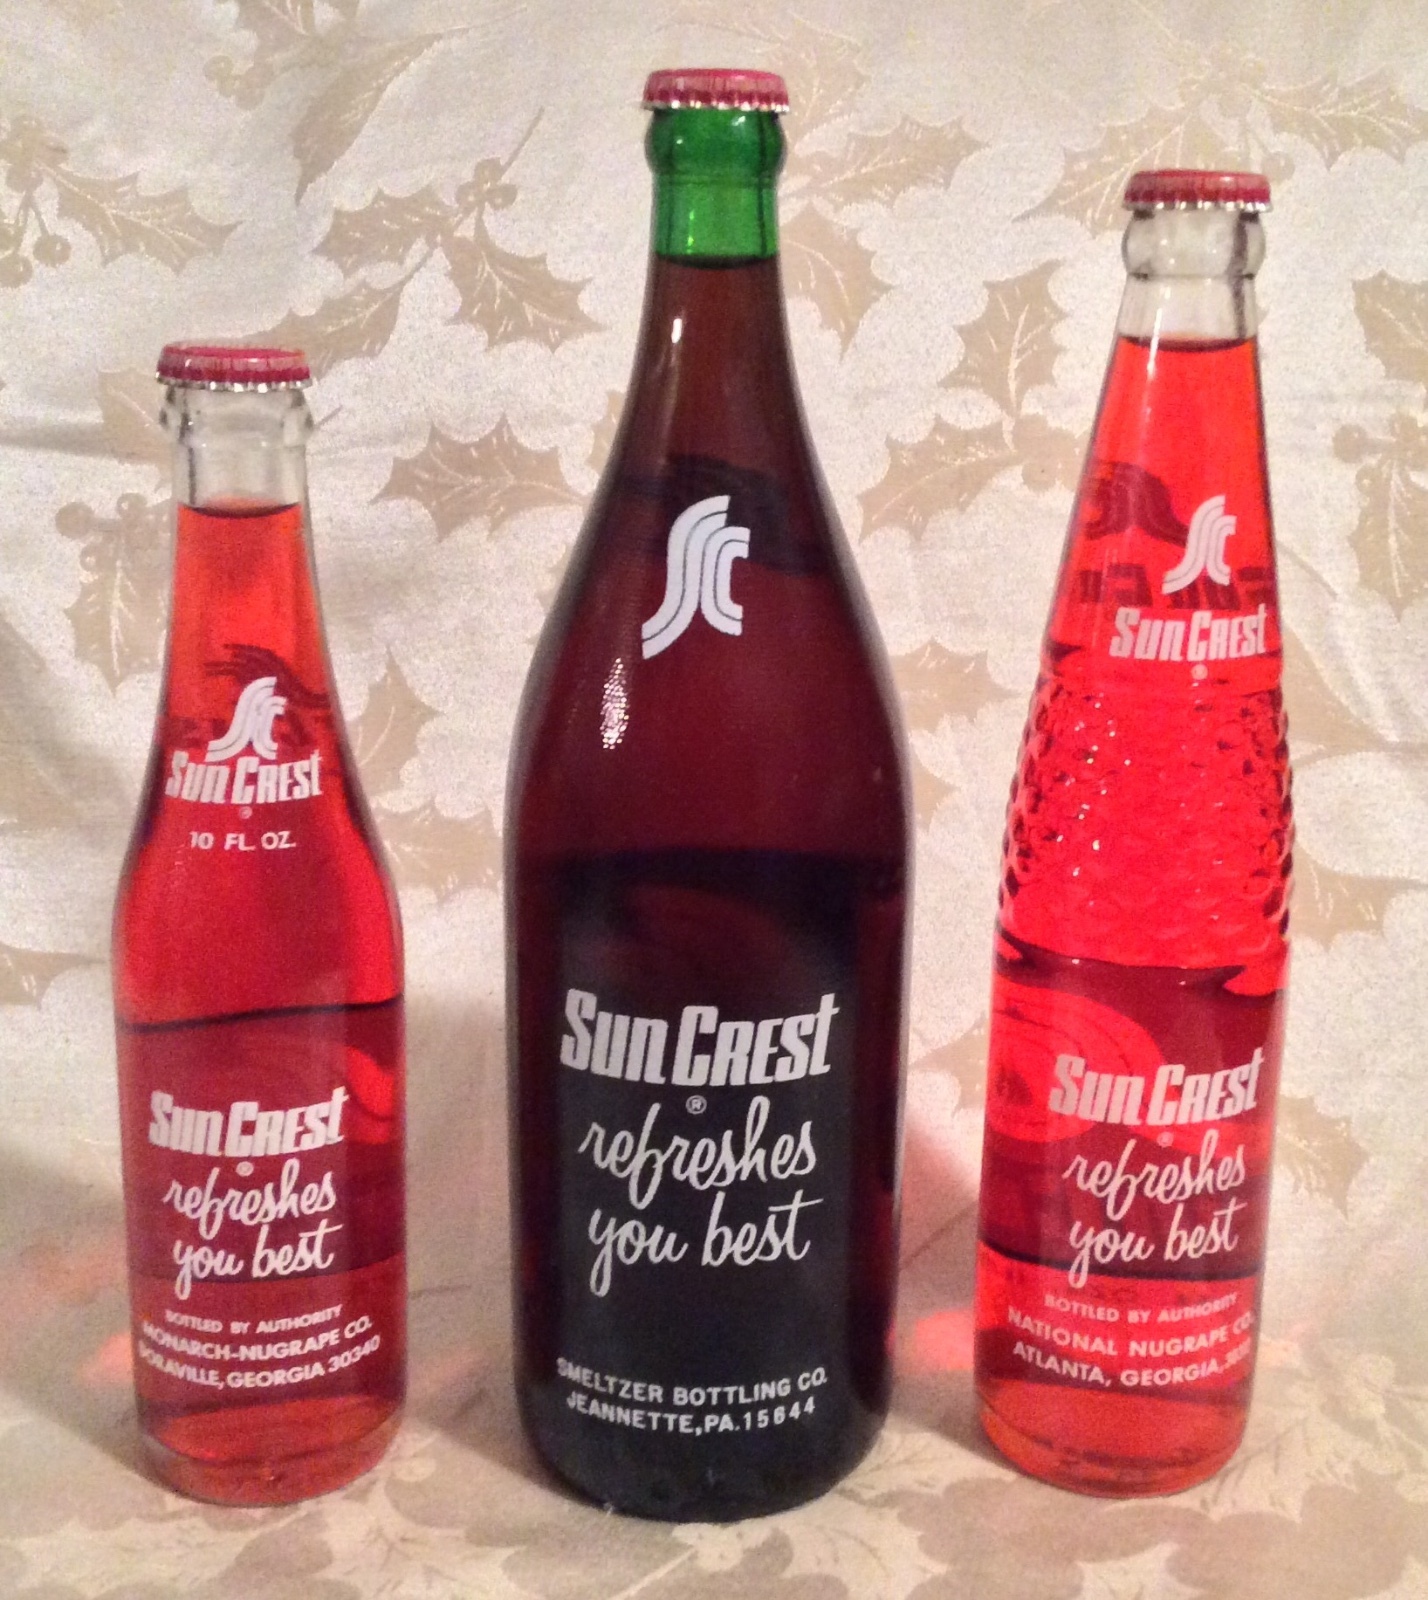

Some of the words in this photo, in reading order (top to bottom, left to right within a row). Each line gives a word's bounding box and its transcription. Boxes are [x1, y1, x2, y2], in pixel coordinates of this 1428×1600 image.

[189, 831, 213, 850] 10
[260, 831, 296, 850] OZ.
[578, 1095, 816, 1210] refreshes
[1062, 1129, 1245, 1221] refreshes
[162, 1157, 336, 1240] refreshes
[172, 1240, 244, 1300] you
[252, 1218, 344, 1278] best
[588, 1208, 689, 1297] you
[701, 1189, 823, 1266] best
[1068, 1221, 1154, 1288] you
[1164, 1197, 1248, 1261] best
[165, 1309, 223, 1333] BOTTLED
[230, 1321, 250, 1334] BY
[256, 1304, 342, 1333] AUTHORITY
[344, 1315, 373, 1339] CO.
[1008, 1305, 1118, 1357] NATIONAL
[1129, 1325, 1229, 1358] NUGRAPE
[1045, 1294, 1119, 1322] BOTTLED
[1128, 1310, 1151, 1324] BY
[1157, 1292, 1237, 1323] AUTHORITY
[227, 1362, 325, 1388] GEORGIA
[328, 1334, 381, 1373] 30340
[556, 1357, 663, 1403] SMELTZER
[673, 1377, 790, 1406] BOTTLING
[797, 1367, 828, 1391] CO.
[1013, 1341, 1112, 1387] ATLANTA,
